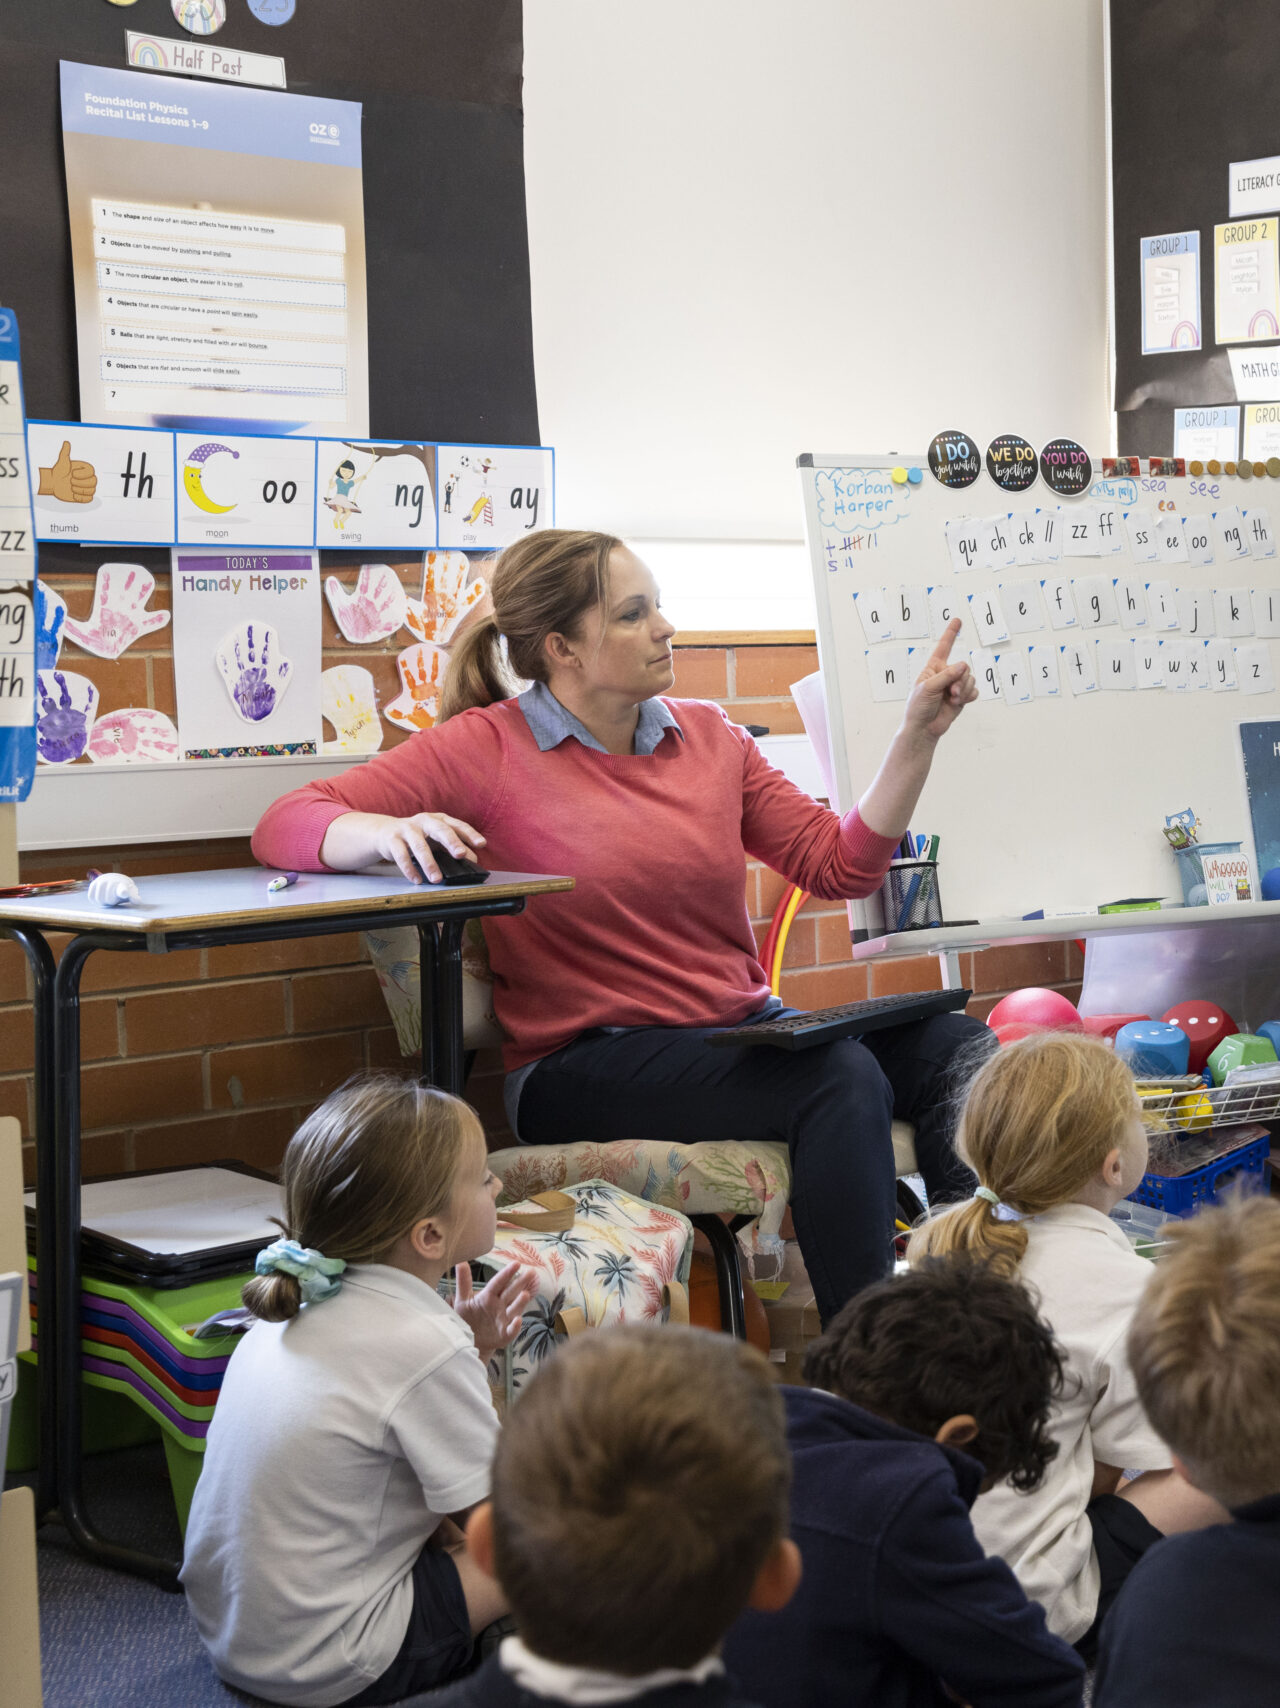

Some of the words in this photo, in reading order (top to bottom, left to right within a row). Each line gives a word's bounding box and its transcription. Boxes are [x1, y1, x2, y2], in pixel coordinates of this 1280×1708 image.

[173, 46, 204, 70] Half
[212, 53, 242, 76] Past
[85, 93, 147, 110] Foundation
[150, 101, 188, 115] Physics
[86, 105, 123, 120] Recital
[127, 110, 145, 122] List
[148, 112, 189, 128] Lessons
[1237, 175, 1273, 192] LITERACY
[1224, 226, 1257, 243] GROUP
[1260, 223, 1267, 239] 2
[1150, 238, 1181, 256] GROUP
[1242, 363, 1270, 378] MATH
[936, 444, 942, 462] I
[947, 442, 970, 460] DO
[989, 447, 1012, 462] WE
[1016, 447, 1034, 461] DO
[1042, 451, 1067, 465] YOU
[1070, 452, 1087, 464] DO
[121, 451, 154, 498] th
[935, 463, 953, 482] you
[953, 456, 978, 473] watch
[994, 461, 1034, 479] together
[1051, 468, 1055, 481] I
[1058, 467, 1083, 483] watch
[263, 480, 297, 504] oo
[834, 478, 893, 497] Korban
[1141, 478, 1167, 493] sea
[1189, 480, 1220, 499] see
[395, 483, 424, 528] ng
[510, 487, 539, 529] ay
[834, 499, 893, 517] Harper
[50, 523, 79, 533] thumb
[206, 529, 228, 538] moon
[341, 532, 362, 541] swing
[1019, 521, 1034, 544] ck
[1072, 525, 1087, 539] zz
[1136, 530, 1148, 544] ss
[1252, 519, 1267, 541] th
[463, 533, 477, 542] play
[991, 526, 1006, 551] ch
[1166, 535, 1179, 548] ee
[1192, 536, 1207, 548] oo
[1224, 528, 1241, 551] ng
[959, 537, 977, 566] qu
[226, 558, 268, 569] TODAY'S
[183, 576, 241, 594] Handy
[250, 576, 307, 594] Helper
